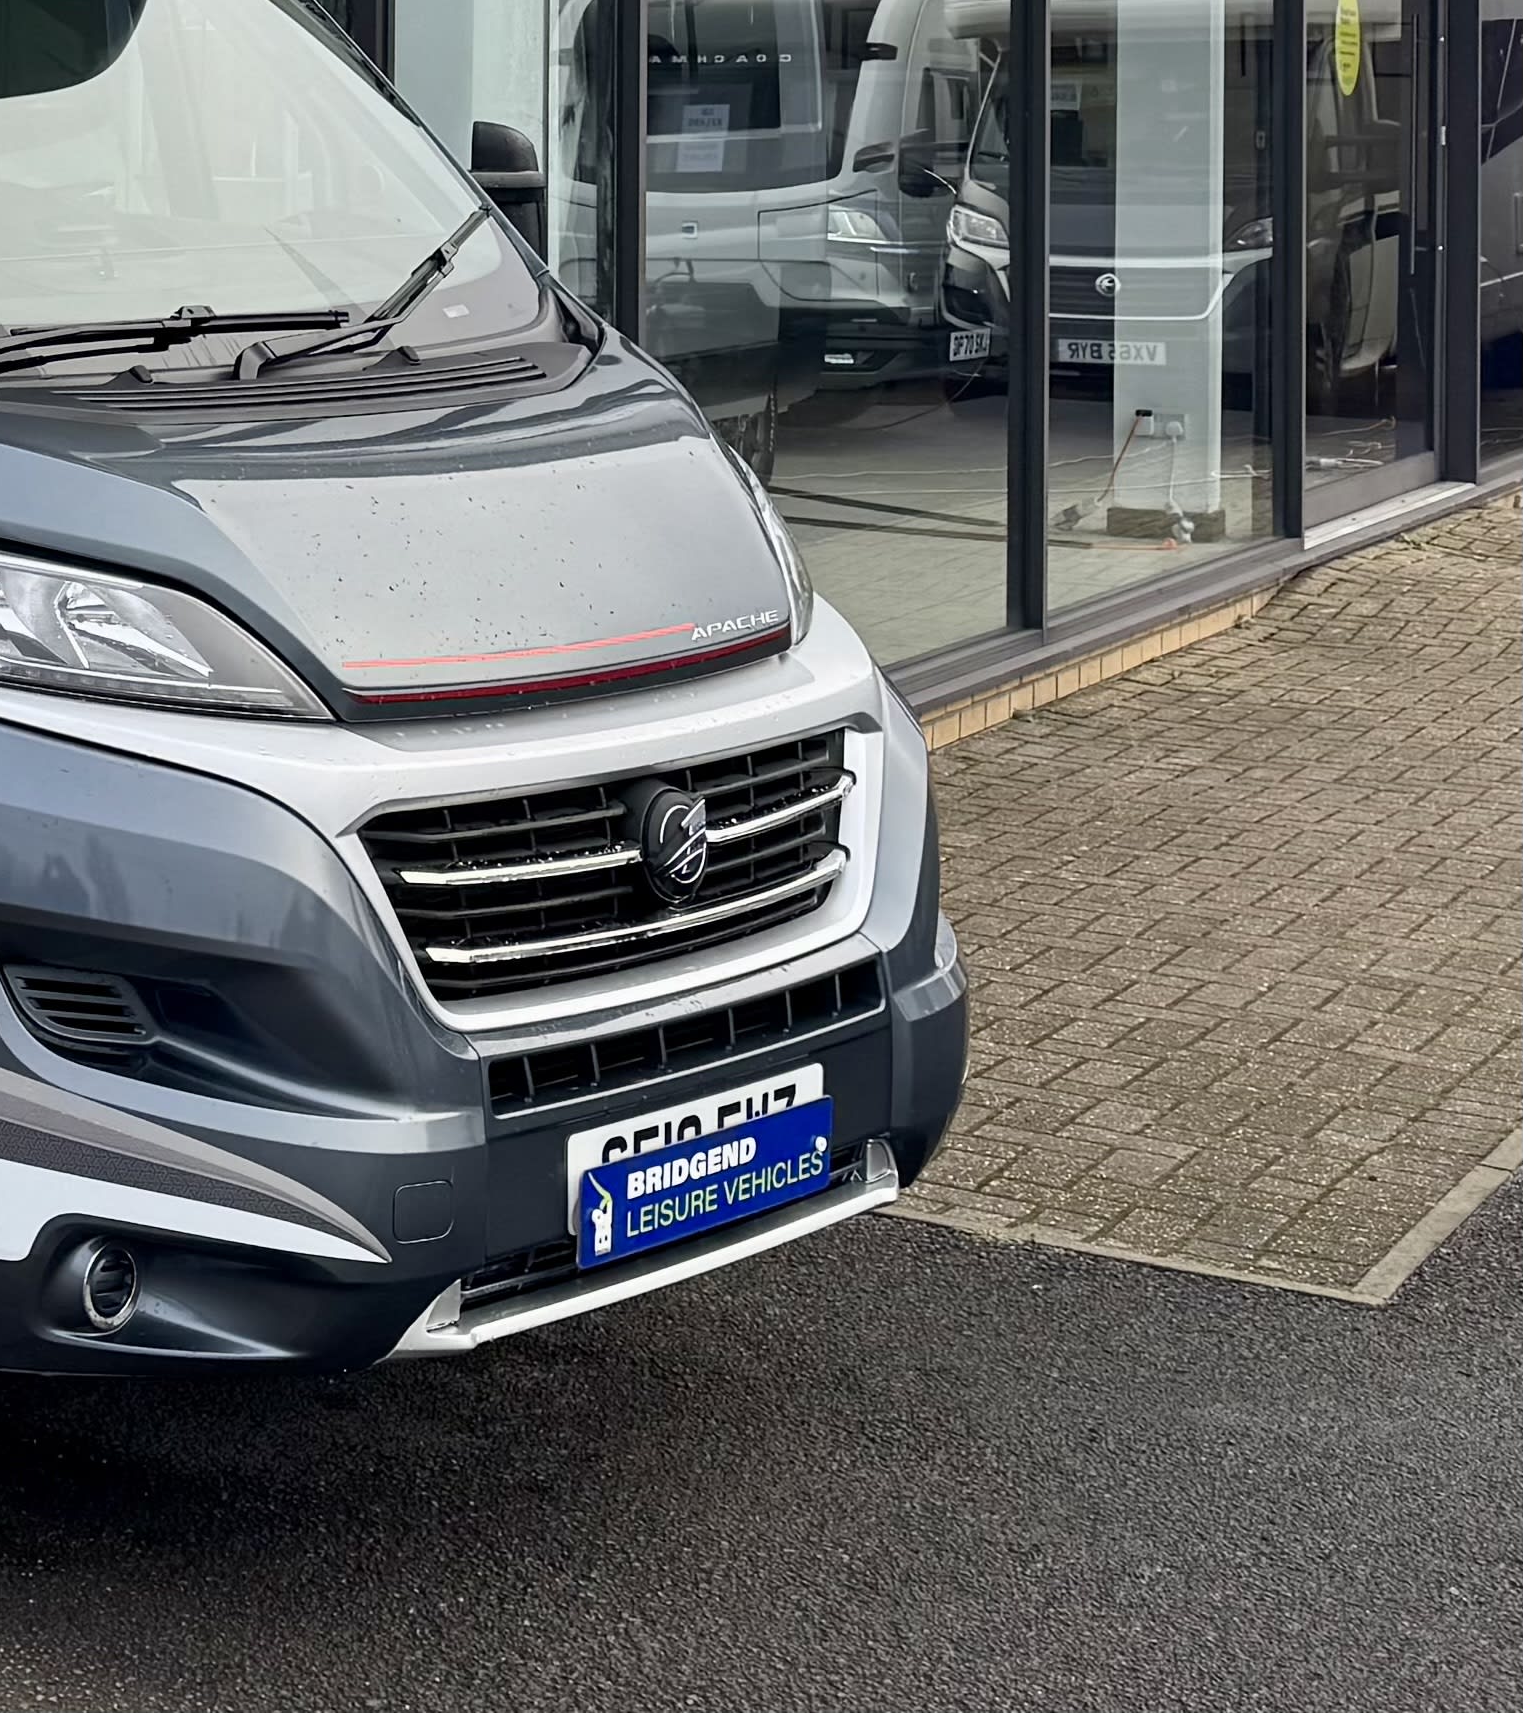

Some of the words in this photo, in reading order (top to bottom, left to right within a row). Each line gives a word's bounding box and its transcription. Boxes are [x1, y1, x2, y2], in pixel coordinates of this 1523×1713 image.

[691, 609, 779, 641] APACHE
[626, 1137, 757, 1200] BRIDGEND
[626, 1184, 718, 1238] LEISURE
[724, 1151, 824, 1205] VEHICLES
